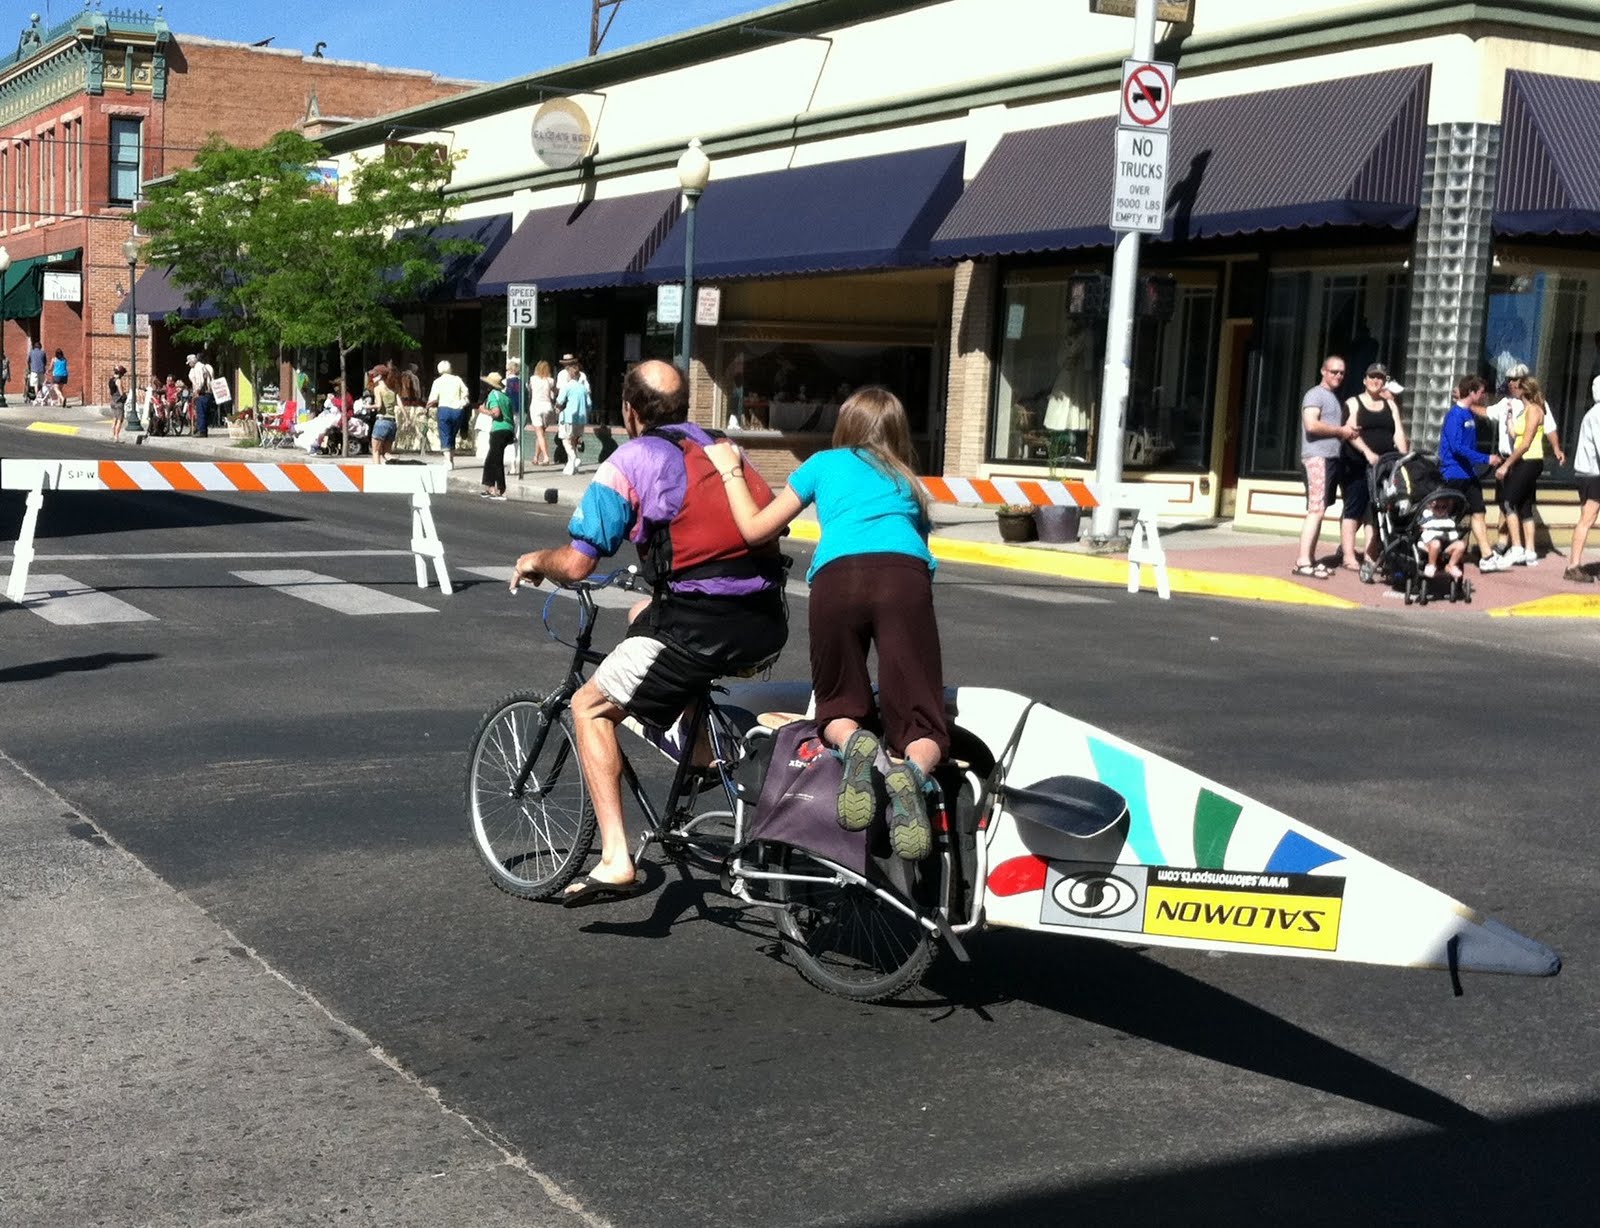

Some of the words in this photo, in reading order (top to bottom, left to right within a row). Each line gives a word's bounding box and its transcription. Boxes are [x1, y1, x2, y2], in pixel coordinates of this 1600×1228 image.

[388, 144, 444, 166] YOA
[1131, 138, 1153, 157] NO
[1120, 161, 1162, 180] TRUCKS
[1129, 184, 1150, 196] OVER
[1116, 198, 1140, 209] 15000
[1145, 199, 1160, 210] LBS
[1115, 212, 1142, 224] EMPTY
[1147, 214, 1158, 224] WT
[509, 288, 536, 297] SPEED
[511, 298, 533, 307] LIMIT
[512, 308, 532, 323] 15
[1157, 869, 1290, 889] www.salomonsports.com
[1155, 899, 1326, 933] SALOMON
